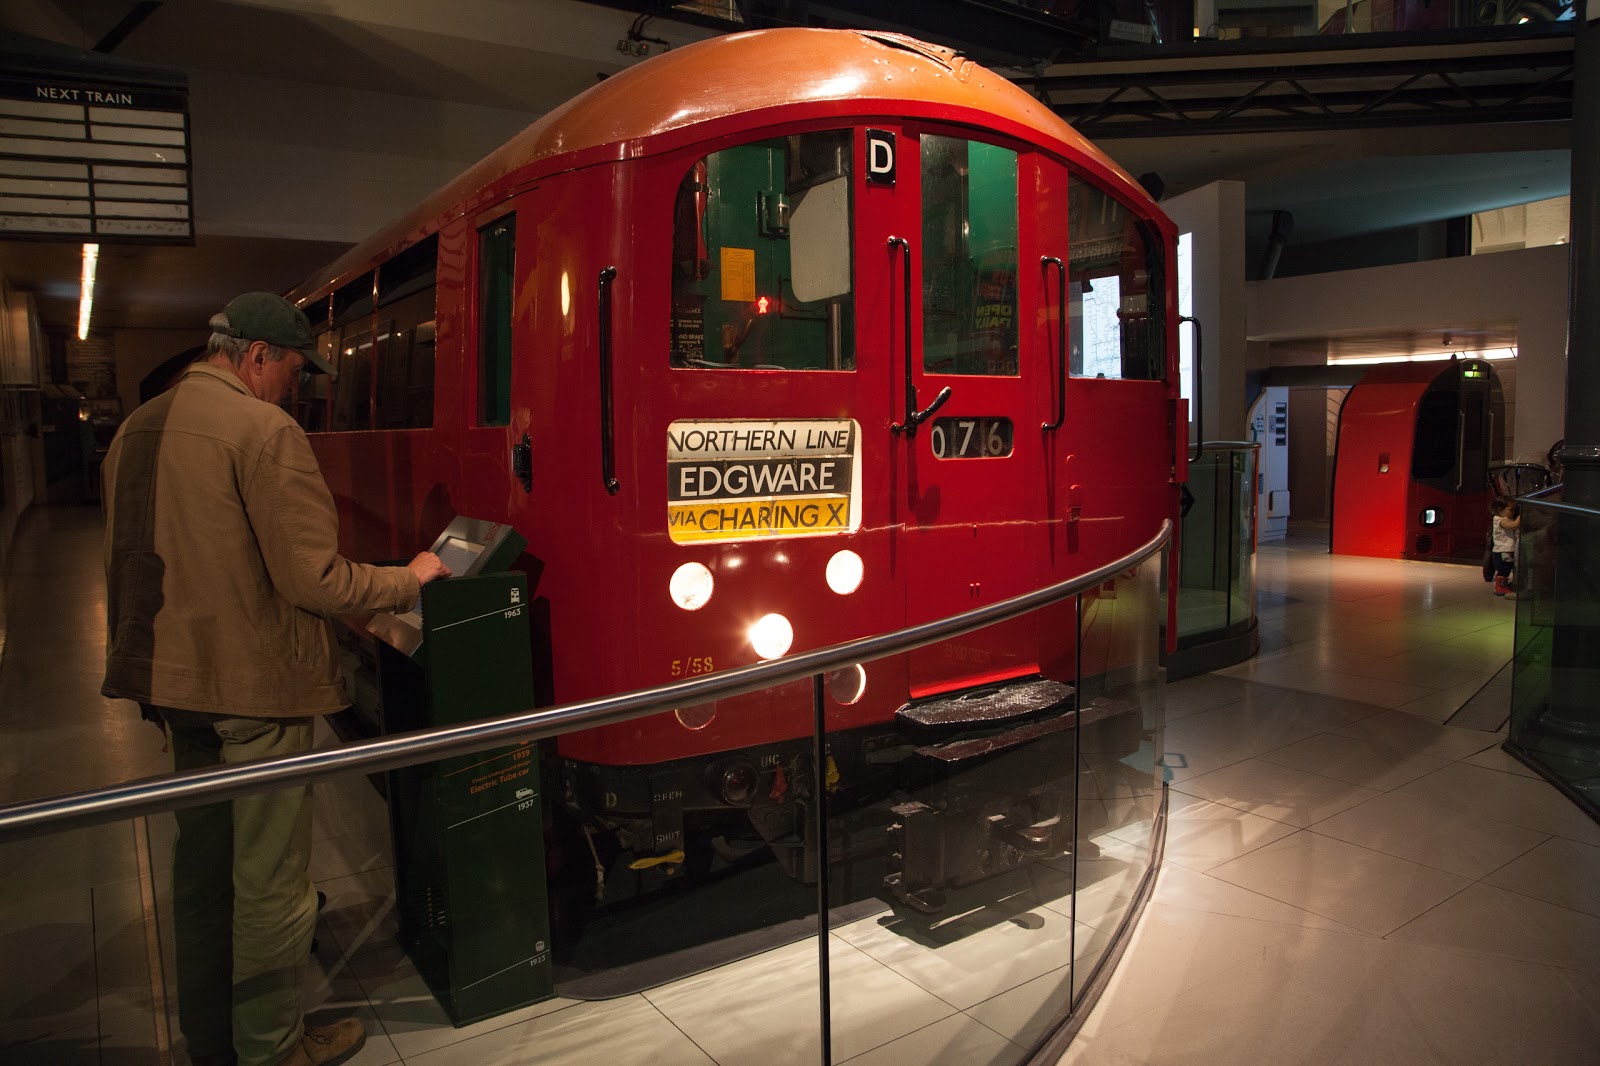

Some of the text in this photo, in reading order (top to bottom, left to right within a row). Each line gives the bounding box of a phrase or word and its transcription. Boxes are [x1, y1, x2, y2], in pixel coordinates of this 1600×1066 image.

[36, 86, 133, 105] NEXT TRAIN
[870, 138, 893, 174] D
[667, 429, 848, 453] NORTHERN LINE
[680, 462, 835, 498] EDGWARE
[668, 502, 844, 534] VIA CHARING X
[504, 608, 521, 619] 1963
[513, 750, 530, 761] 1939
[470, 768, 530, 795] Electric Tube car
[517, 799, 534, 811] 1937
[656, 830, 681, 844] SHUT
[530, 955, 546, 967] 1923
